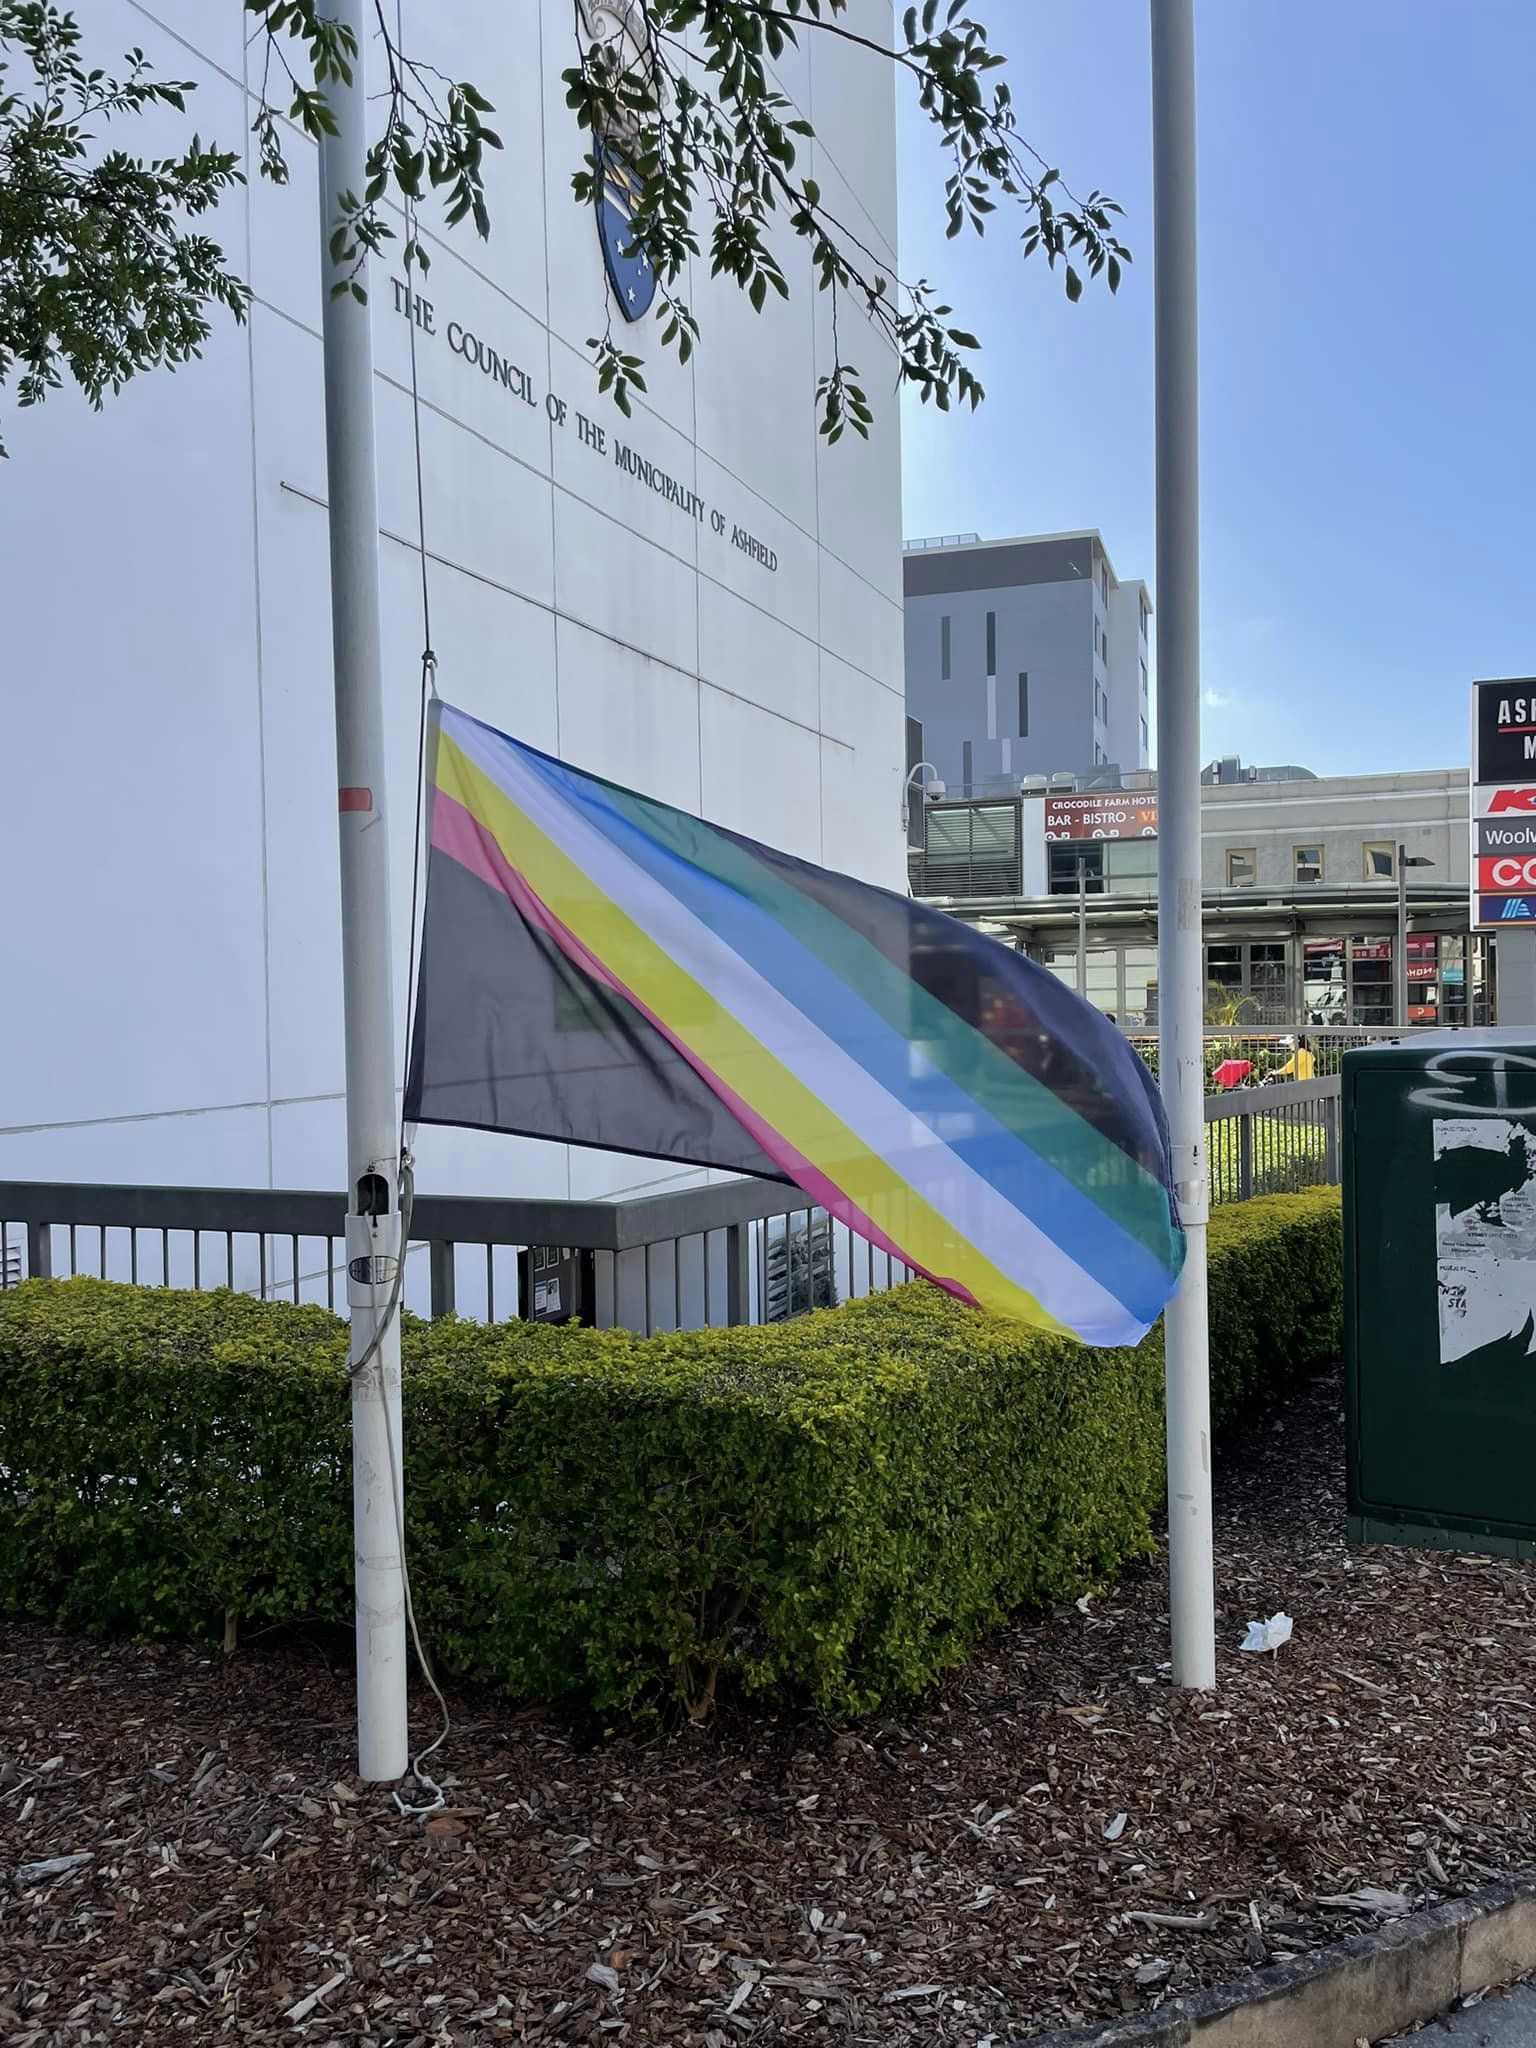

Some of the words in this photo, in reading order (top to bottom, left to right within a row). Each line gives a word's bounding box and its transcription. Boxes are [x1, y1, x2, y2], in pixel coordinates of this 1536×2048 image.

[390, 276, 437, 336] THE
[447, 321, 538, 408] COUNCIL
[545, 393, 568, 427] OF
[575, 411, 607, 456] THE
[614, 439, 706, 523] MUNICIPALITY
[710, 509, 727, 536] OF
[731, 524, 779, 572] ASHFIELD
[1052, 799, 1102, 810] CROCODILE
[1105, 798, 1130, 808] FARM
[1047, 814, 1072, 826] BAR
[1083, 811, 1127, 825] BISTRO
